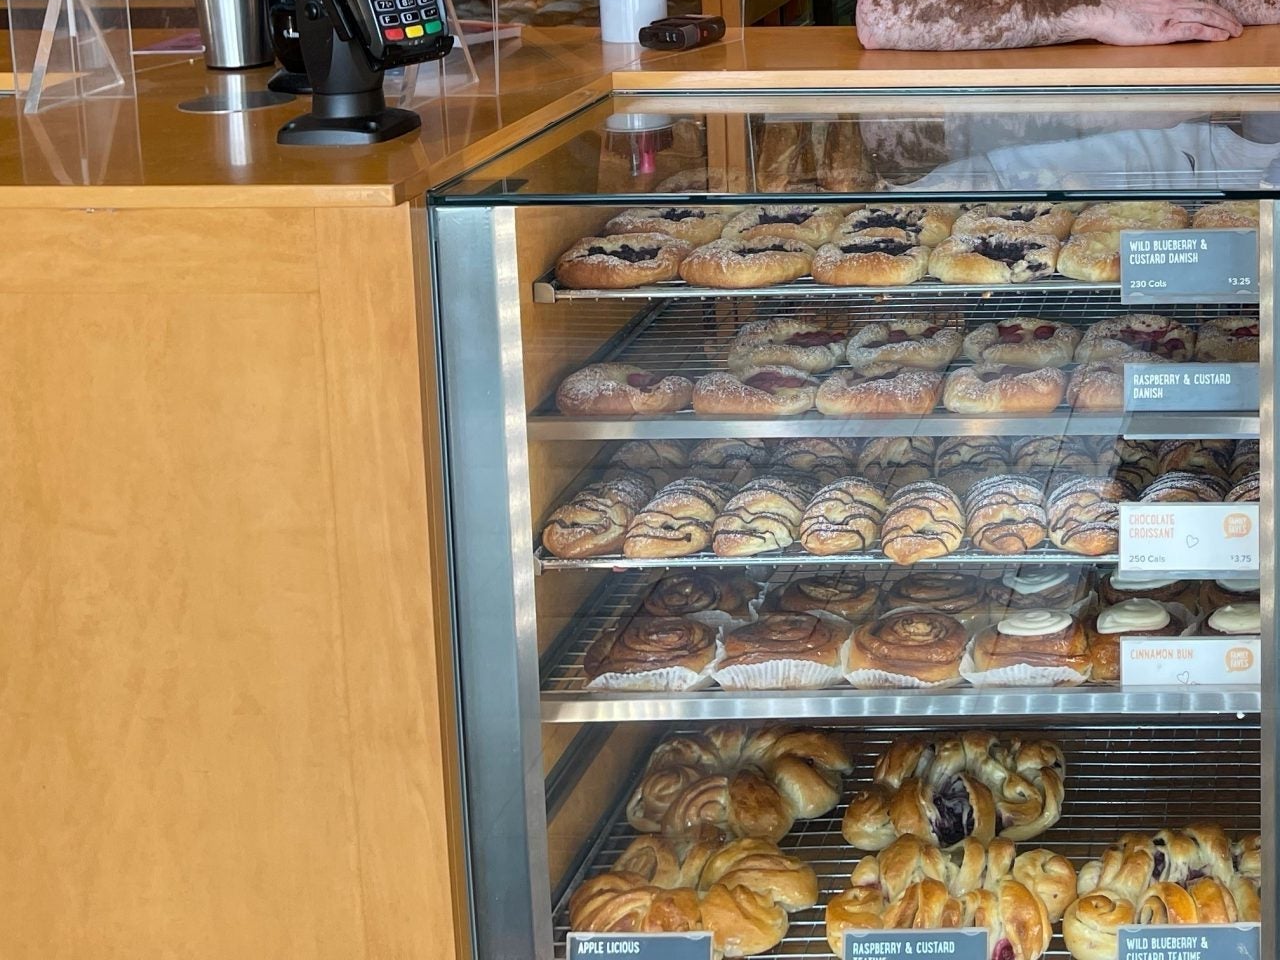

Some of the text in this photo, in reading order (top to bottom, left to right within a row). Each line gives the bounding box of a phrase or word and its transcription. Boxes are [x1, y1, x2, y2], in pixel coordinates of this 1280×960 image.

[1129, 239, 1208, 251] WILD BLUEBERRY &
[1129, 252, 1199, 265] CUSTARD DANISH
[1130, 279, 1167, 288] 230 Cals
[1228, 277, 1251, 285] $3.25
[1133, 374, 1231, 385] RASPBERRY & CUSTARD
[1133, 388, 1164, 399] DANISH
[1129, 514, 1175, 525] CHOCOLATE
[1129, 528, 1175, 539] CROISSANT
[1129, 554, 1166, 563] 250 Cals
[1230, 554, 1252, 562] $3.75
[1130, 649, 1193, 660] CINNAMON BUN
[577, 941, 641, 954] APPLE LICIOUS
[852, 941, 955, 955] RASPBERRY & CUSTARD
[1126, 936, 1208, 950] WILD BLUEBERRY &
[1126, 951, 1201, 960] CUSTARD TEATIME
